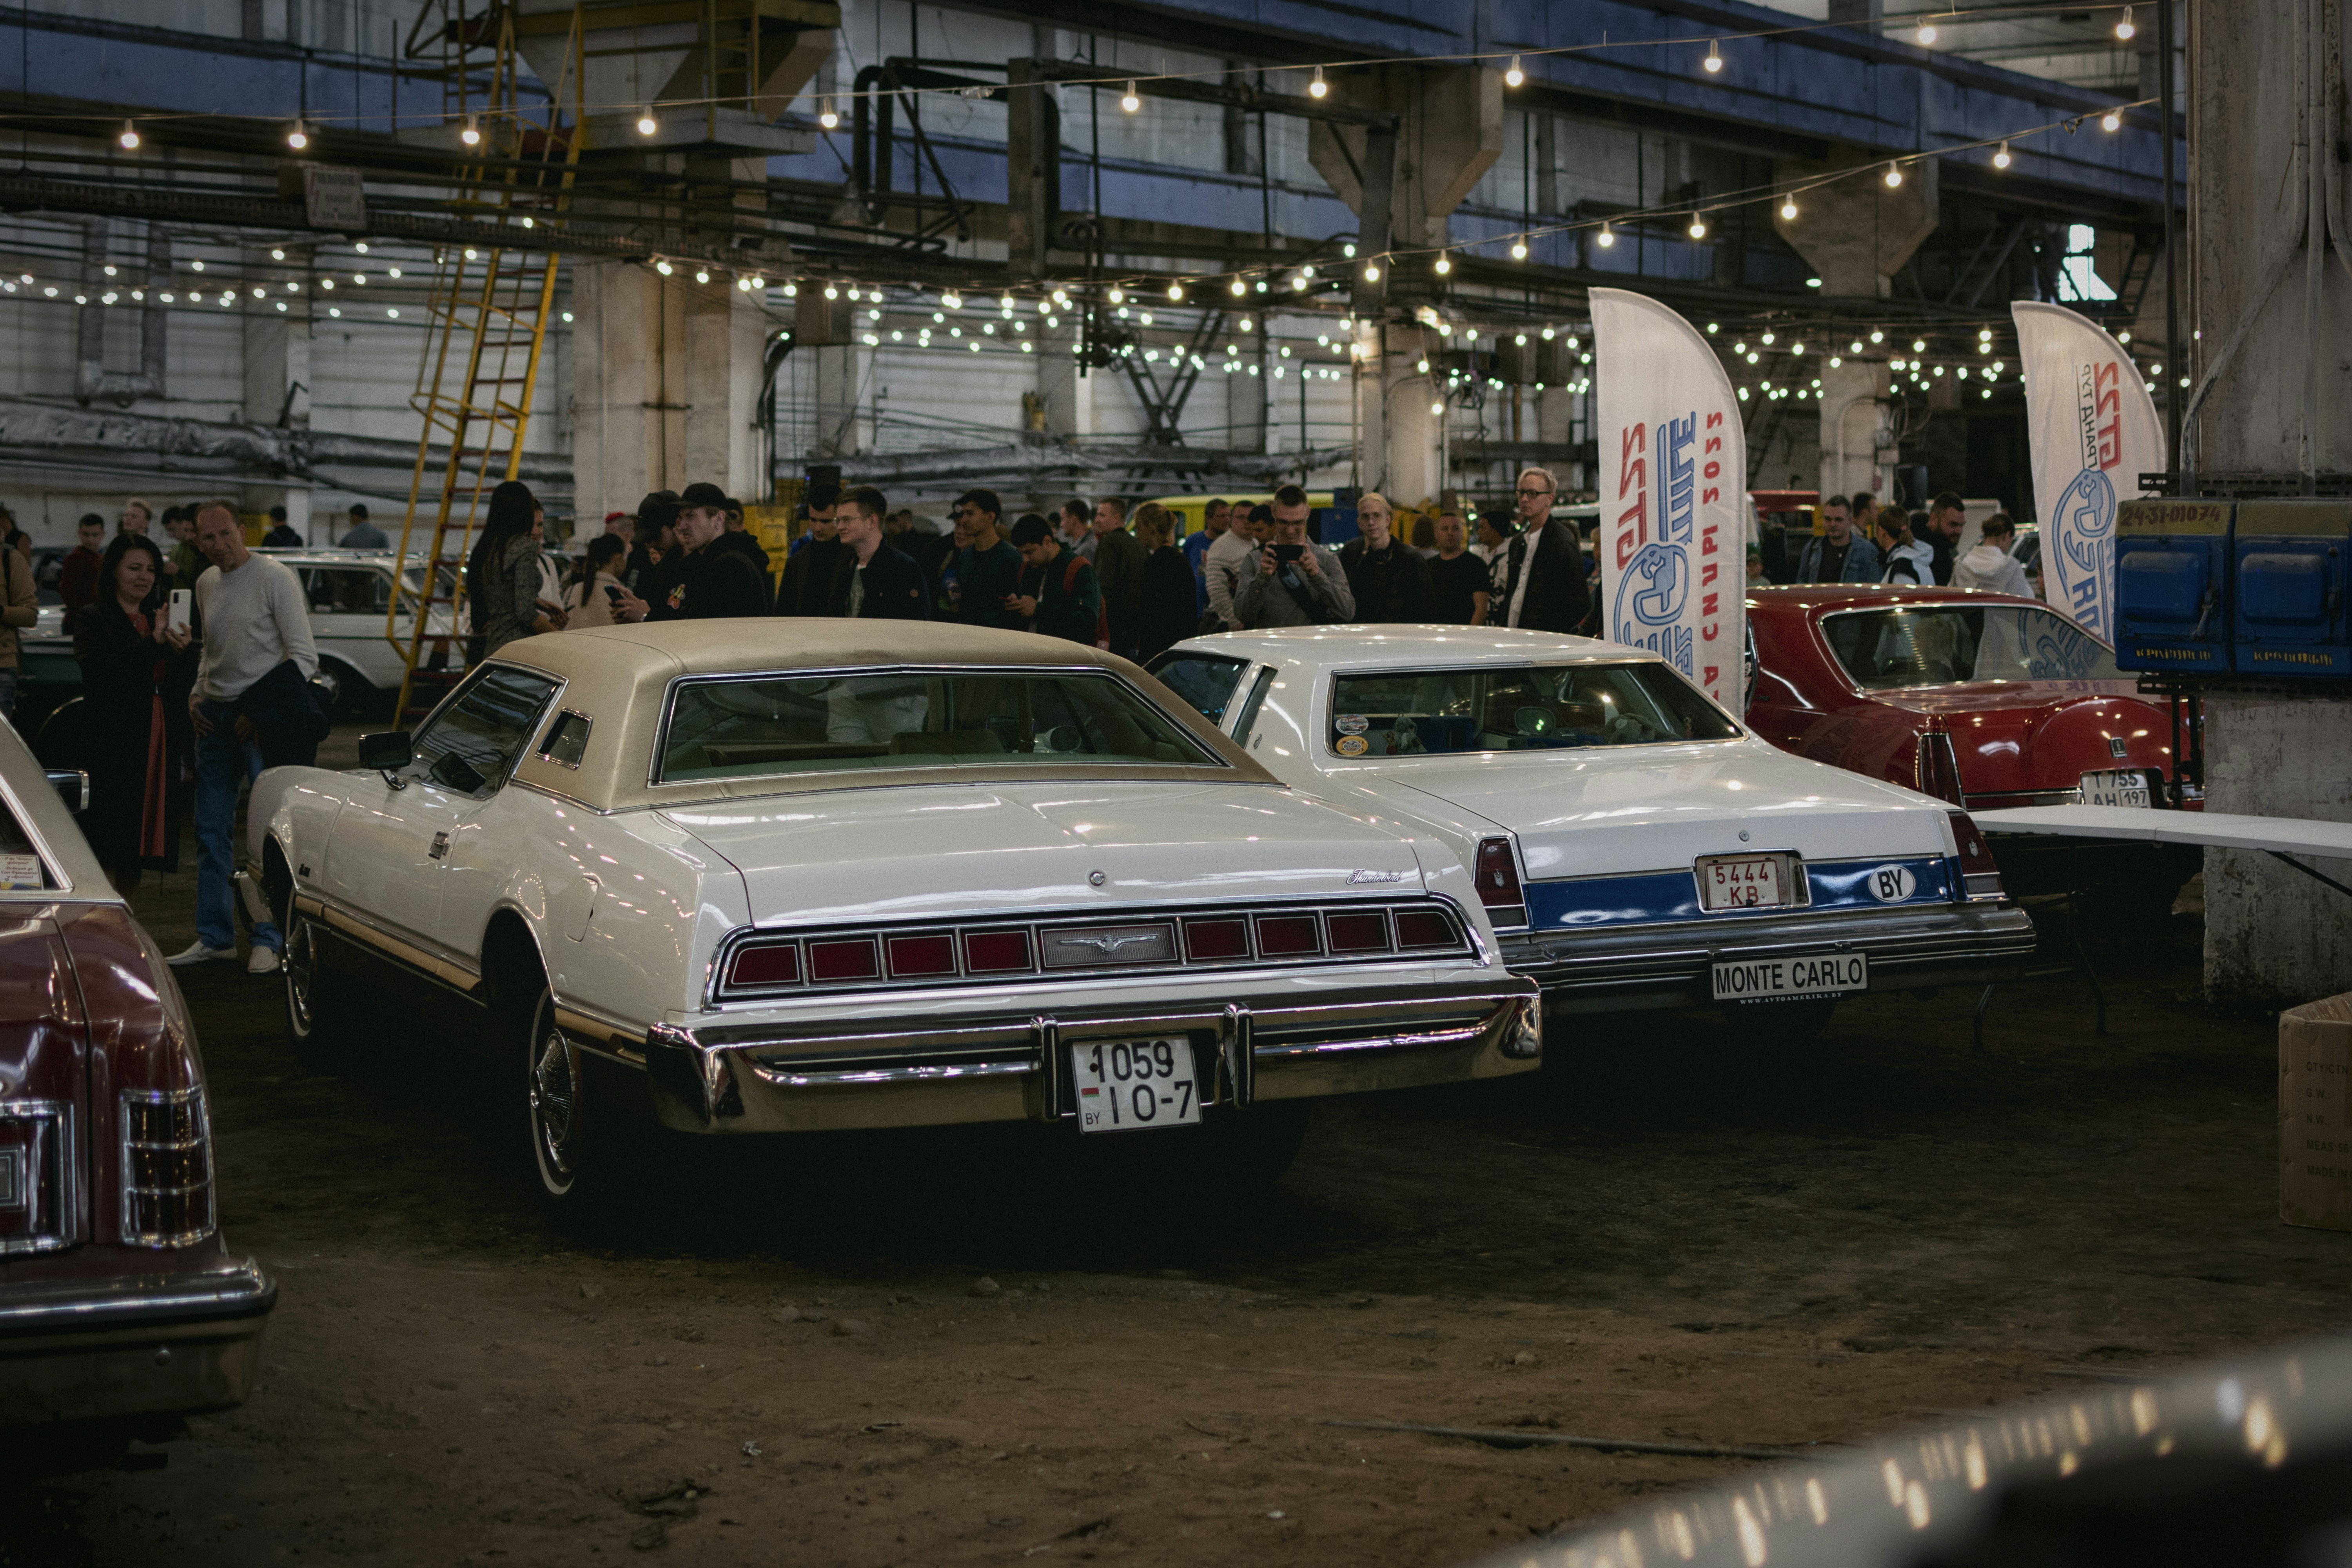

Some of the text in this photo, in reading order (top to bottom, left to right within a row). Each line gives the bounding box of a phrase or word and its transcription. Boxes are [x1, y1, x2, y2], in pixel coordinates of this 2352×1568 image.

[2108, 769, 2138, 786] 755
[2124, 791, 2146, 804] 197
[1346, 868, 1404, 885] Thunderbird
[1715, 863, 1768, 884] 5444
[1877, 869, 1902, 898] BY
[1730, 886, 1759, 905] KB
[1715, 958, 1862, 994] MONTE CARLO
[1740, 992, 1842, 1004] WWW.AVTOAMERIKA.BY
[1092, 1040, 1174, 1082] 1059
[1085, 1112, 1100, 1125] BY
[2308, 1165, 2335, 1177] MADE
